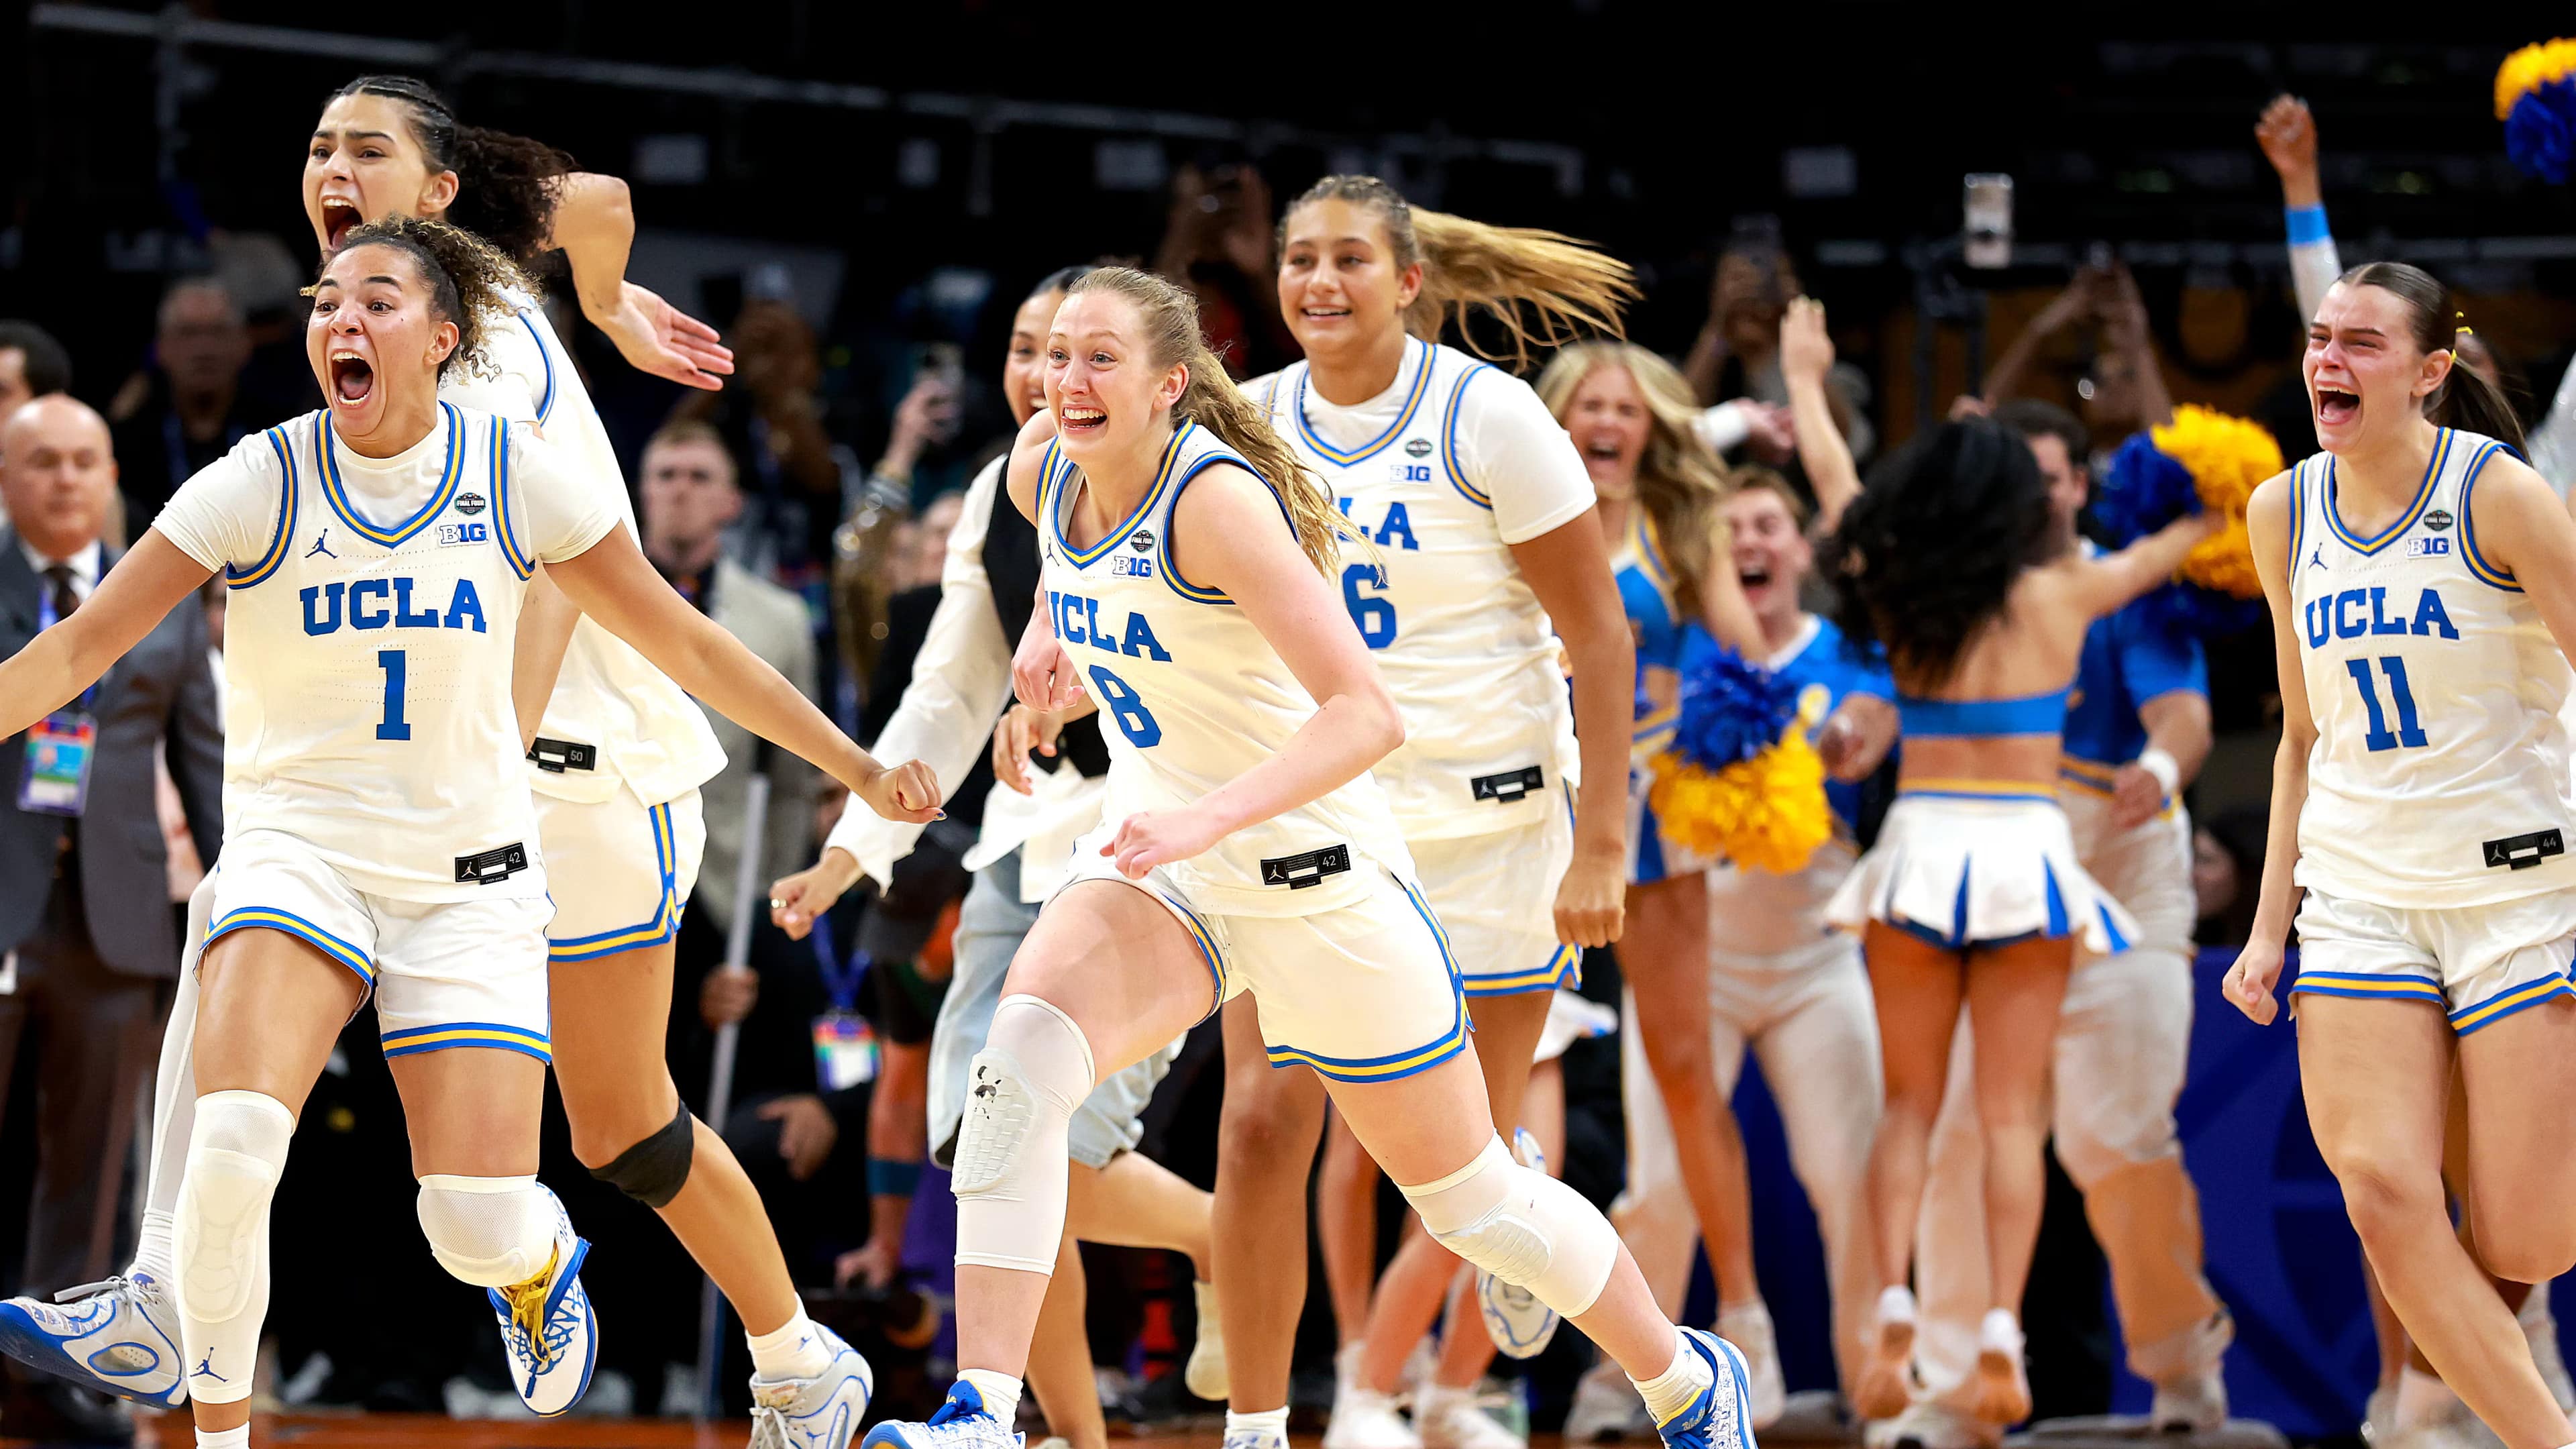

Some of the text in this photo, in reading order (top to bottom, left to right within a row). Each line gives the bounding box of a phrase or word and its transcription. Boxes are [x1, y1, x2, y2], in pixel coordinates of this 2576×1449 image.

[1330, 497, 1419, 551] LA
[300, 578, 486, 636] UCLA
[1342, 564, 1397, 649] 6
[2306, 587, 2460, 649] UCLA
[376, 650, 411, 741] 1
[1089, 664, 1162, 748] 8
[2345, 656, 2428, 751] 11
[570, 750, 583, 761] 50
[509, 852, 521, 864] 42
[1322, 855, 1336, 867] 42
[2543, 837, 2557, 848] 44
